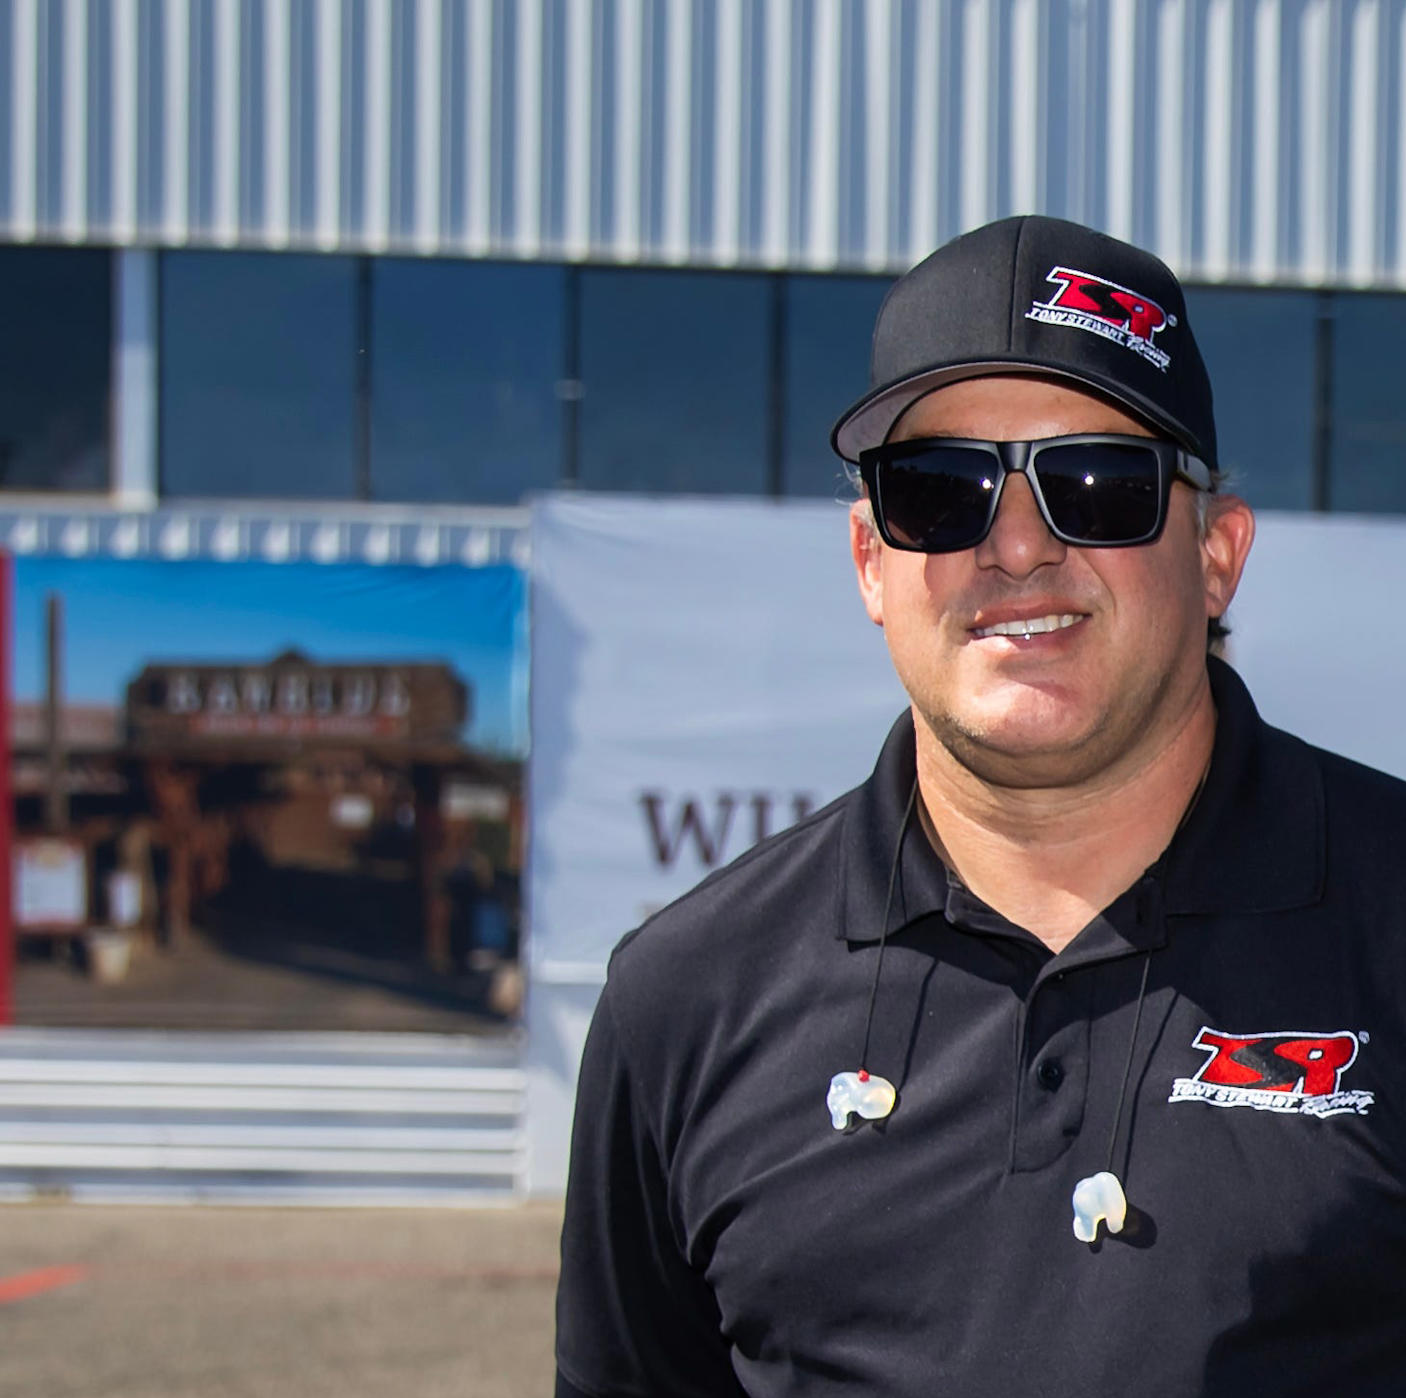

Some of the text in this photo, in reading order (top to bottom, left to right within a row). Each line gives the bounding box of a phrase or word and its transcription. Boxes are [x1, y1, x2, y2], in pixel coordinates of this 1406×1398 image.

[1066, 313, 1126, 343] STEWART
[1172, 1081, 1213, 1101] TONY
[1214, 1088, 1299, 1110] STEWART
